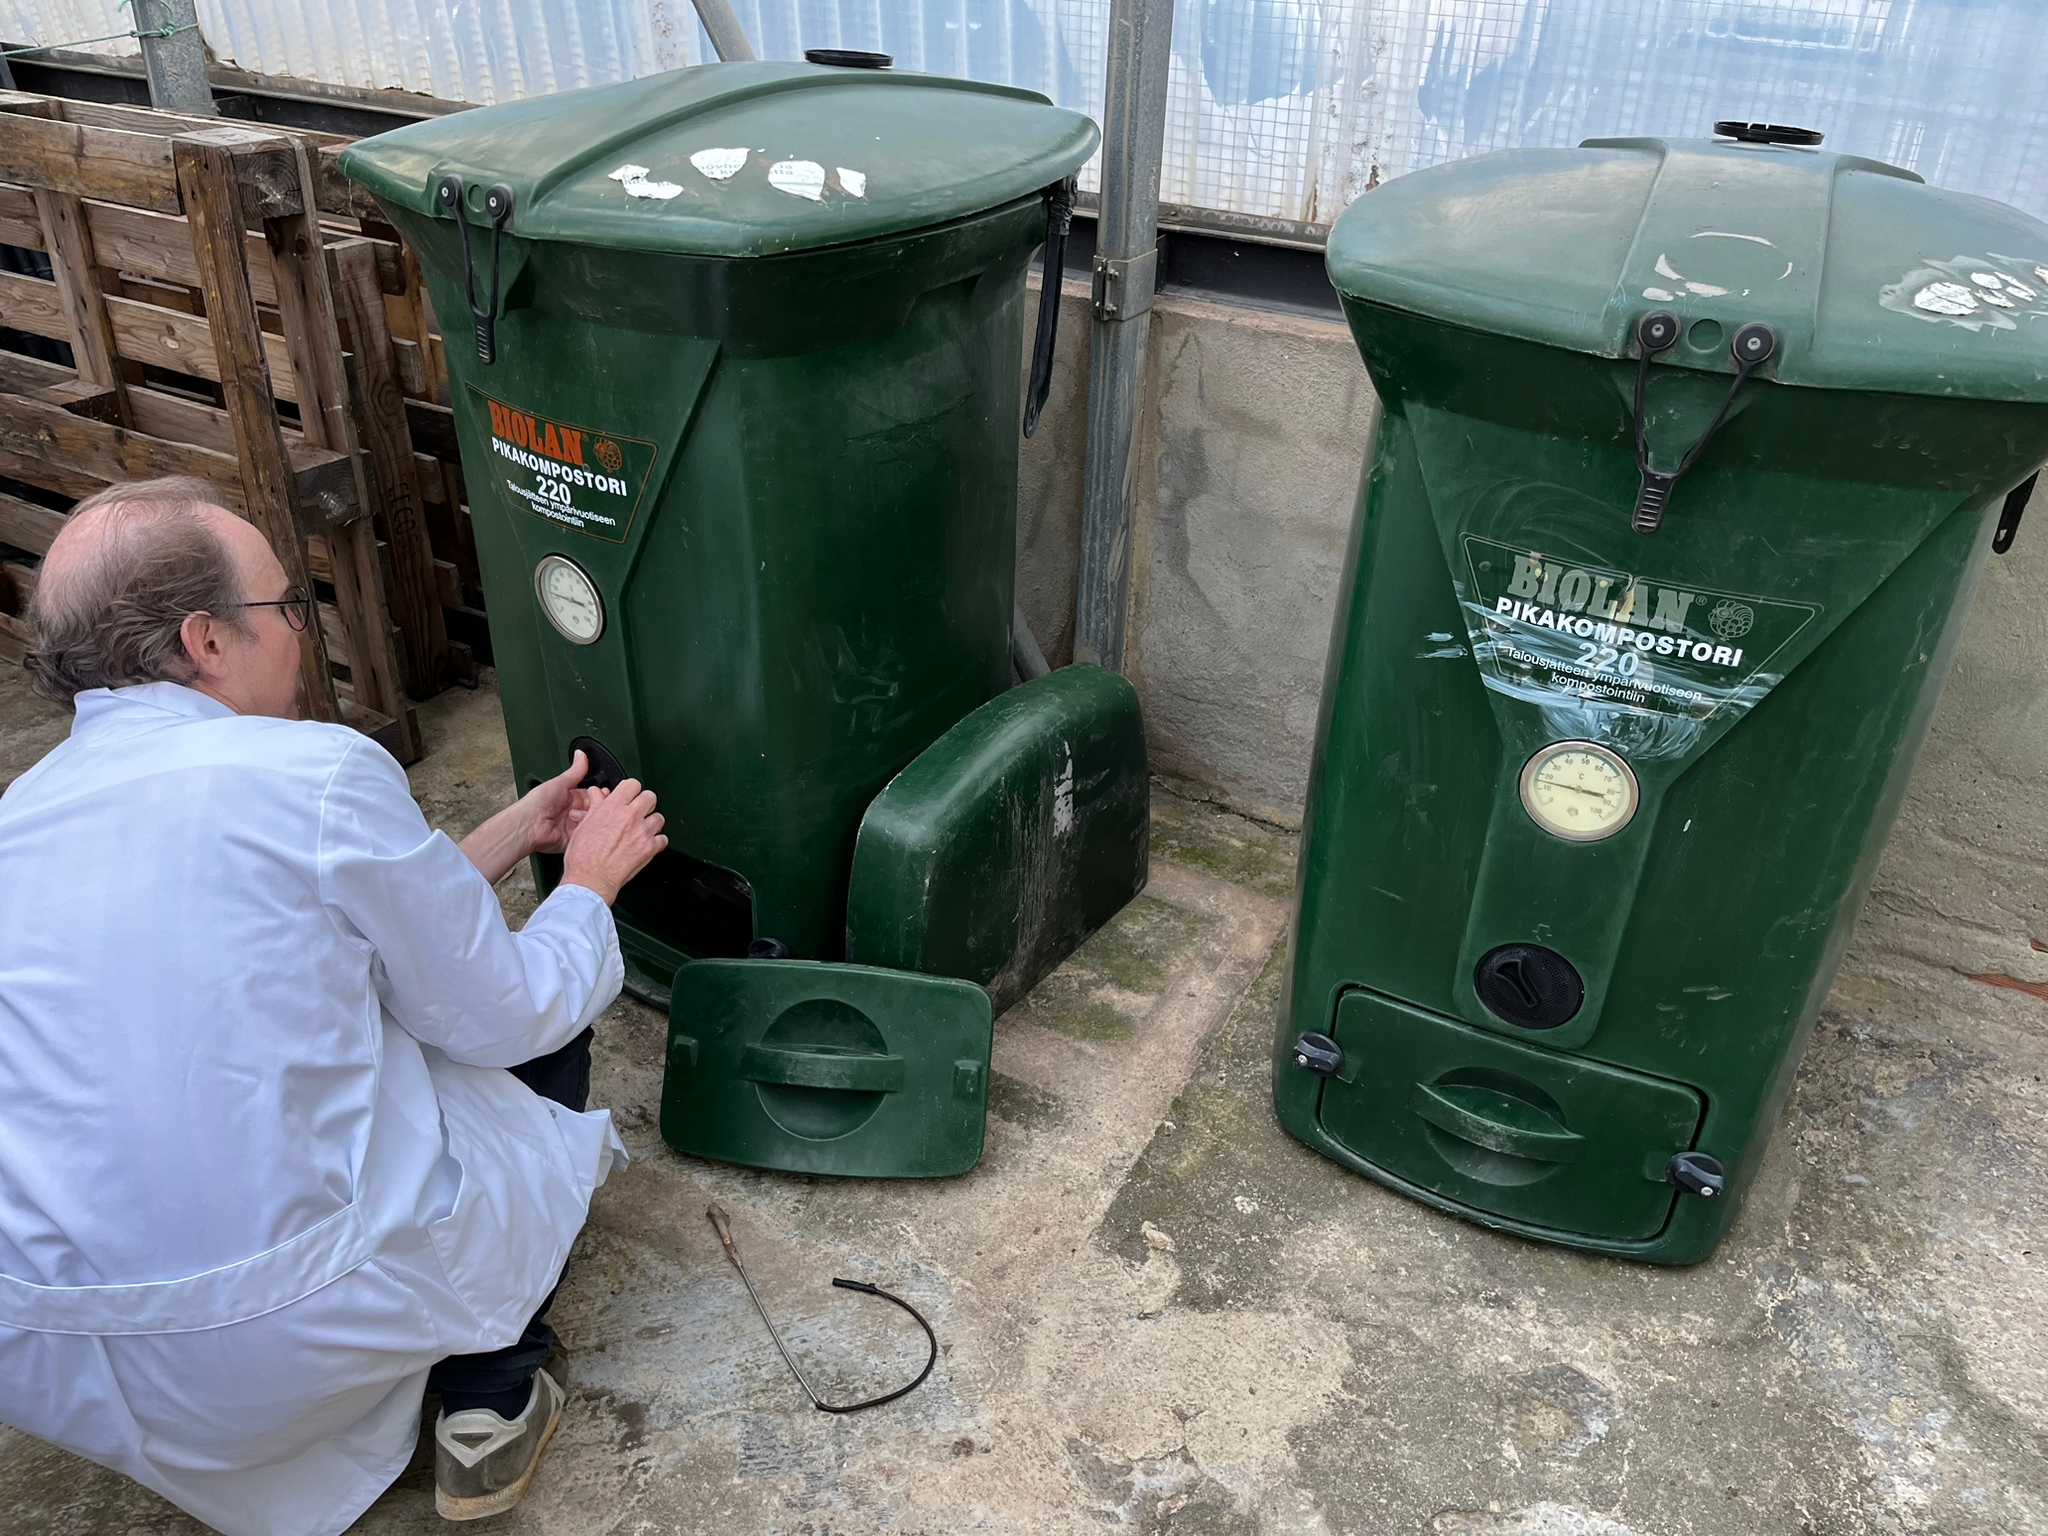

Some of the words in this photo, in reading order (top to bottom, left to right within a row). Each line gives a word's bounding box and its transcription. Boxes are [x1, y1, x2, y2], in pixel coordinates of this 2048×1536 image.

[488, 400, 584, 466] BIOLAN
[491, 436, 628, 497] PIKAKOMPOSTORI
[535, 475, 572, 506] 220
[530, 501, 585, 528] kompostointiin
[1507, 554, 1697, 634] BIOLAN
[1495, 596, 1744, 667] PIKAKOMPOSTORI
[1506, 646, 1590, 678] Talousjätteen
[1592, 669, 1703, 702] ympärivuotiseen
[1574, 642, 1640, 677] 220
[1551, 671, 1646, 704] kompostointiin
[1552, 764, 1562, 772] 30
[1580, 757, 1590, 766] 50
[1594, 765, 1604, 773] 60
